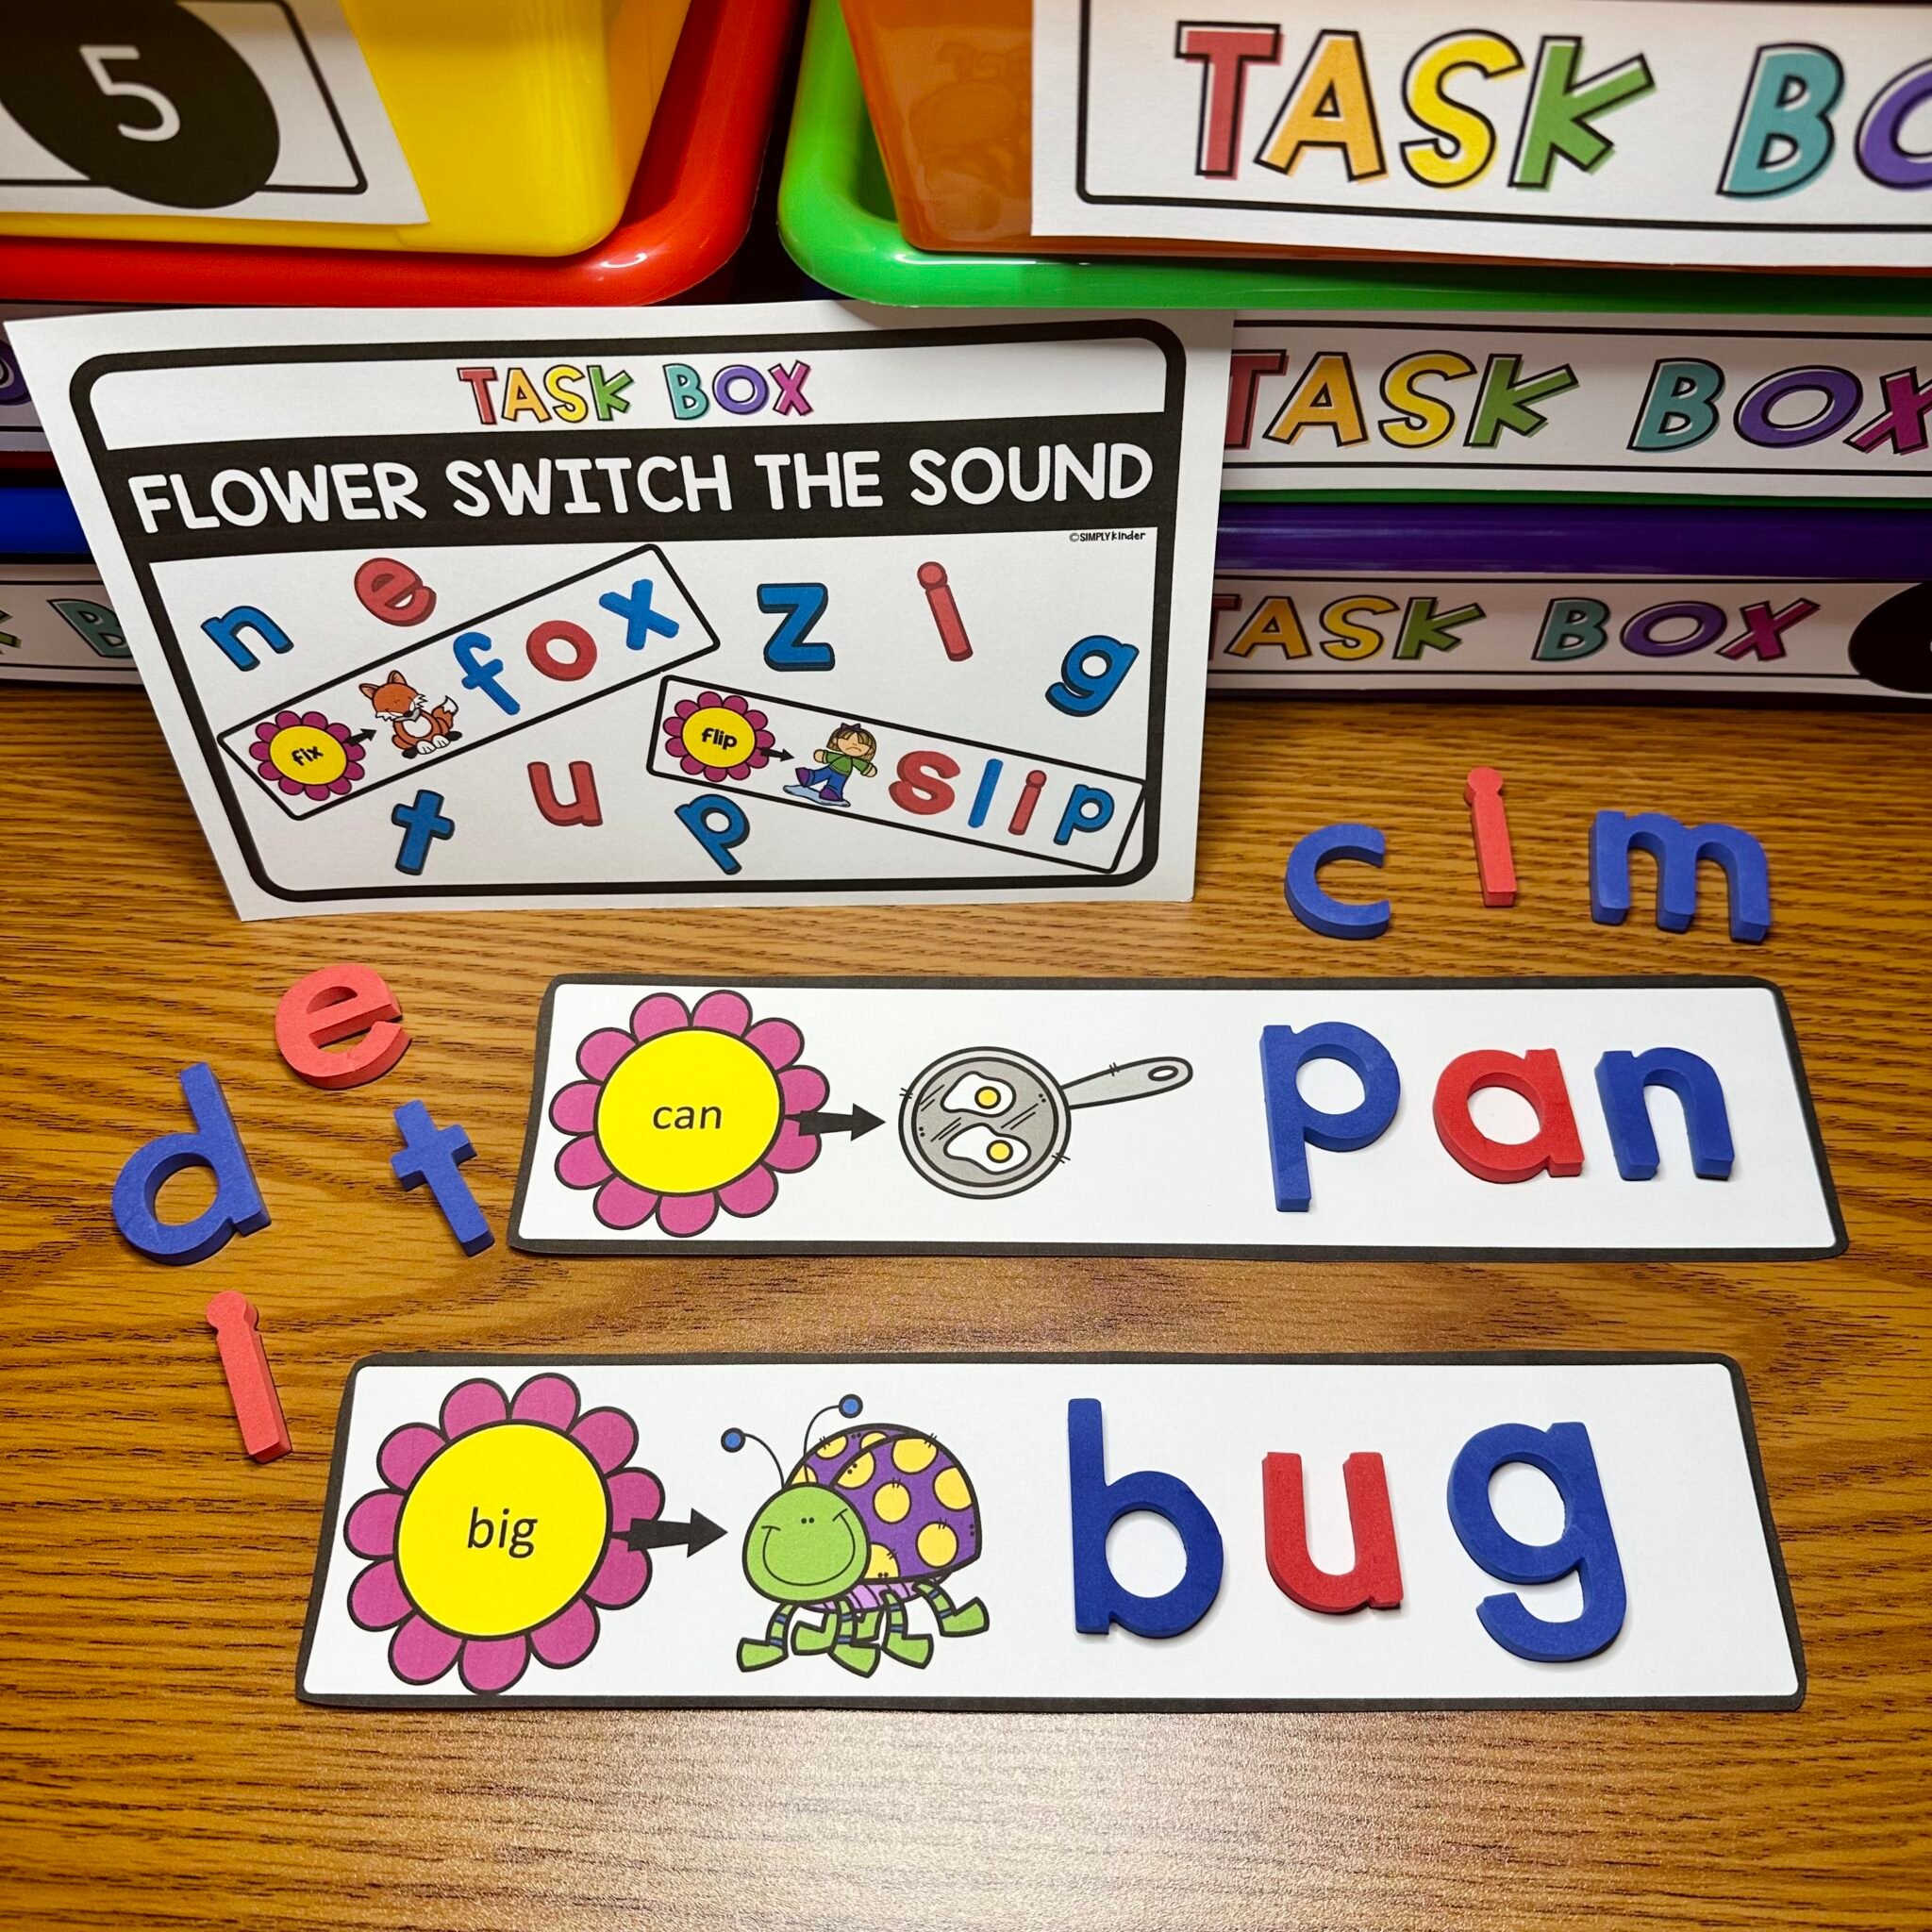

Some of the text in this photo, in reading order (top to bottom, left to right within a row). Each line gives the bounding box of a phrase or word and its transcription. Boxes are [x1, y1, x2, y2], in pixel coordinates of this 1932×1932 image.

[78, 44, 181, 142] 5
[1174, 21, 1657, 192] TASK
[457, 359, 814, 425] TASK BOX
[1224, 348, 1932, 455] TASK BOX
[128, 442, 1153, 534] FLOWER SWITCH THE SOUND
[354, 557, 437, 626] e
[1532, 597, 1821, 662] BOX
[201, 605, 293, 671] n
[453, 578, 679, 716] fox
[1045, 635, 1140, 717] g
[291, 745, 324, 766] fix
[702, 727, 738, 750] flip
[391, 789, 455, 875] t
[527, 760, 603, 827] u
[675, 793, 751, 874] p
[889, 750, 1115, 845] slip
[275, 963, 412, 1090] e
[653, 1103, 723, 1130] can
[1259, 1021, 1735, 1212] pan
[111, 1061, 272, 1266] d
[390, 1099, 495, 1257] t
[467, 1507, 539, 1558] big
[1067, 1398, 1627, 1663] bug
